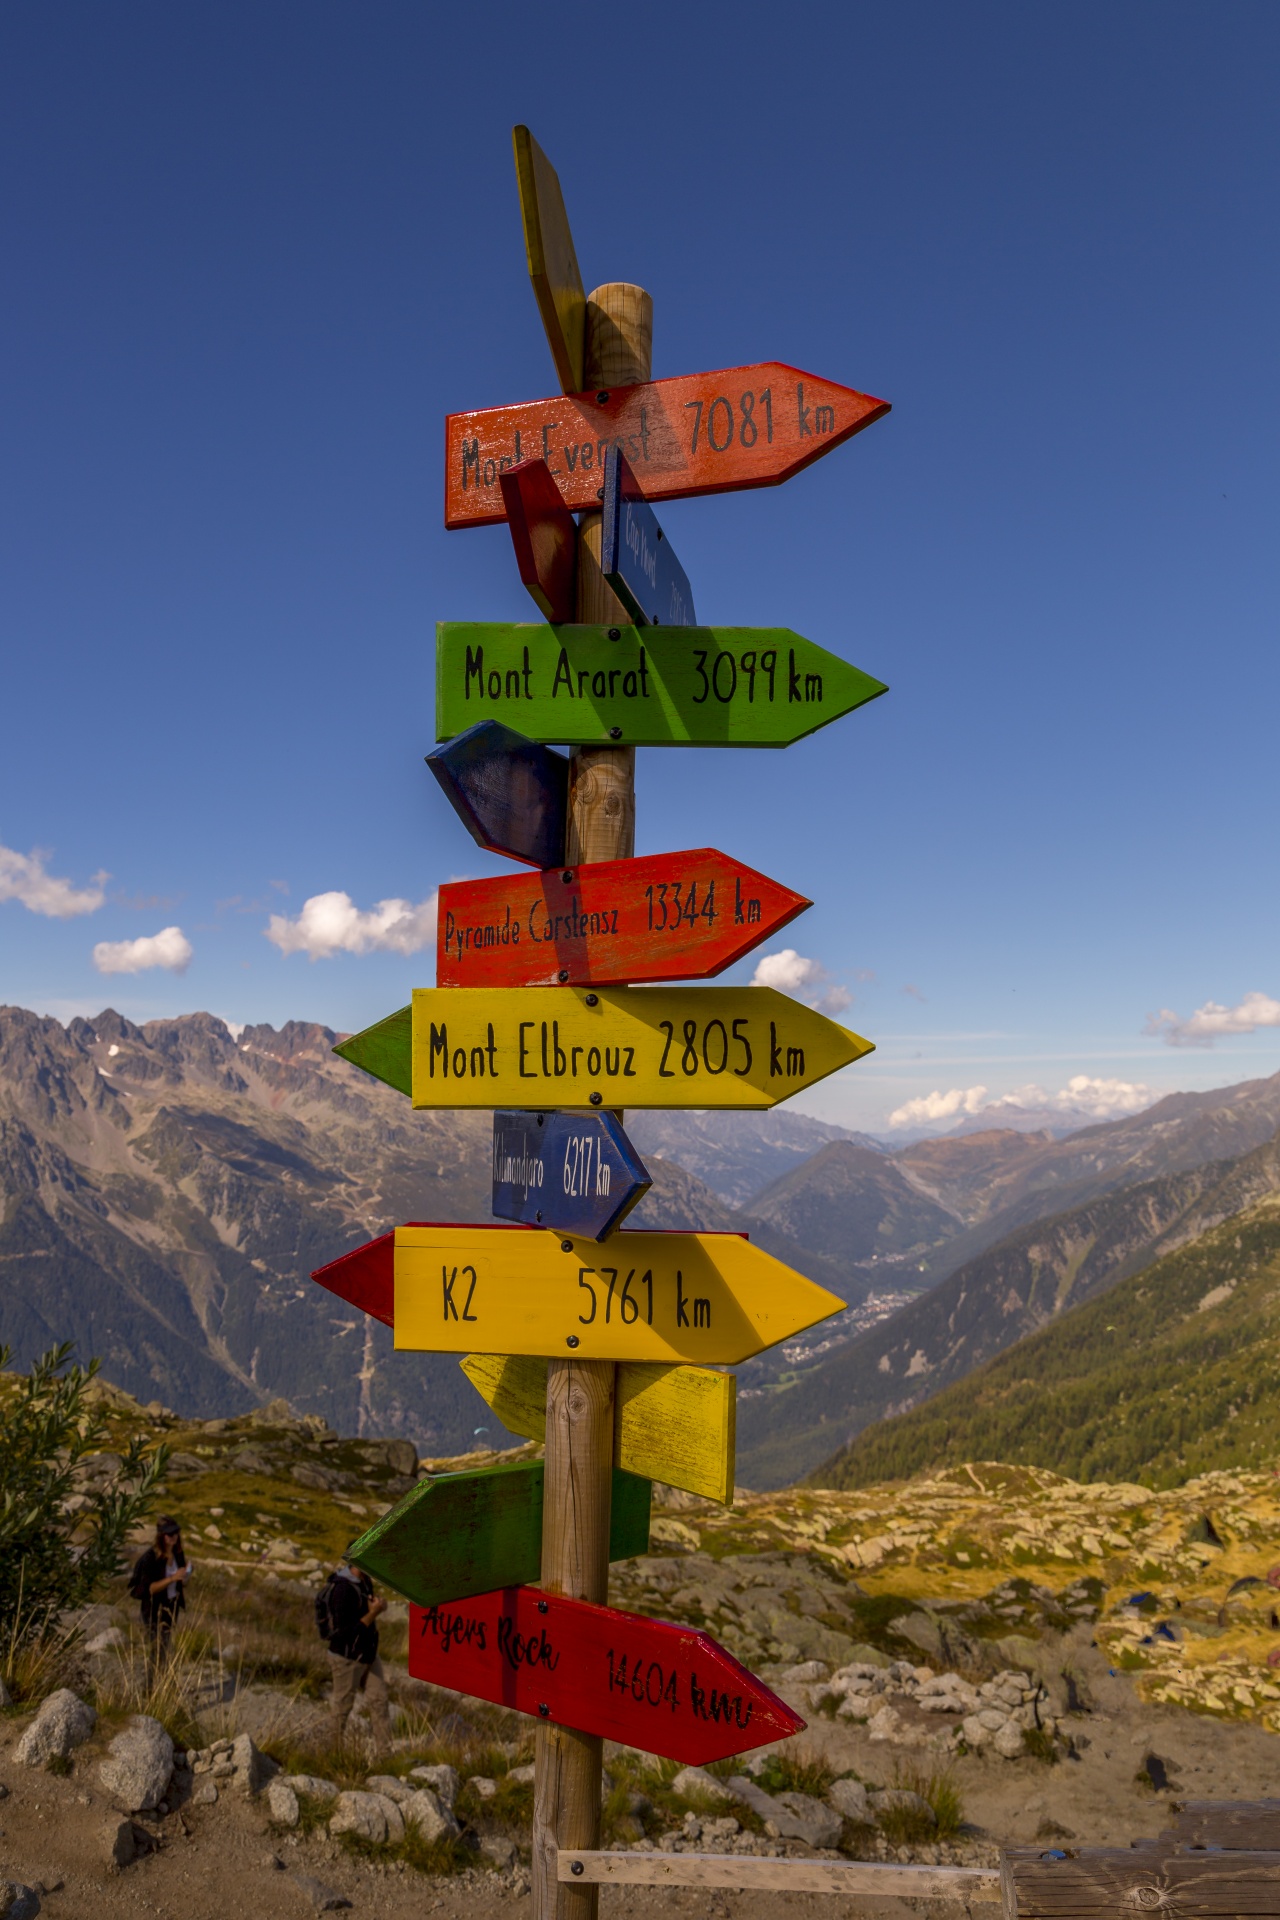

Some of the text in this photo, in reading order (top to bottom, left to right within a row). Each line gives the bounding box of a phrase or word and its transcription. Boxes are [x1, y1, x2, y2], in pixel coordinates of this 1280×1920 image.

[684, 387, 774, 455] 7081
[798, 382, 836, 438] km
[465, 645, 823, 704] Mont Ararat 3099 km
[444, 877, 762, 962] Pyramide Carstensz 13344 km
[429, 1019, 806, 1078] Mont Elbrouz 2805 km
[494, 1131, 611, 1202] Kilimandjaro 6217 km
[442, 1265, 711, 1329] K2 5761 km
[421, 1605, 753, 1730] Ayers Rock 14604 km
